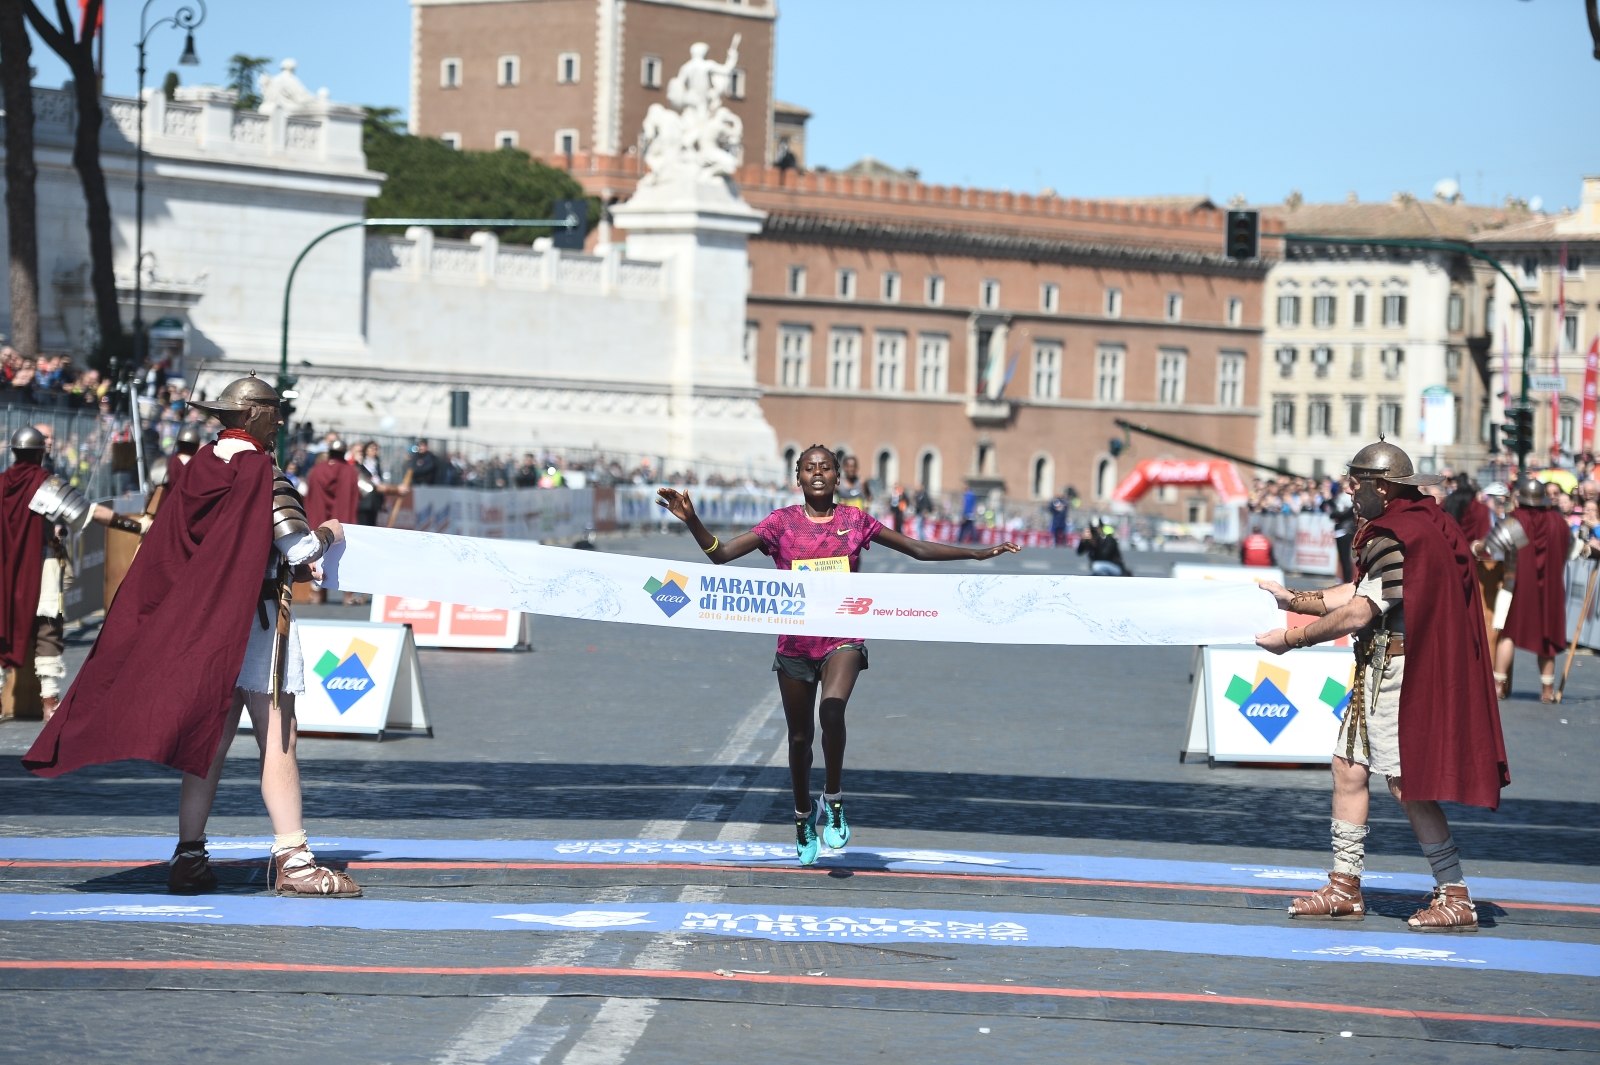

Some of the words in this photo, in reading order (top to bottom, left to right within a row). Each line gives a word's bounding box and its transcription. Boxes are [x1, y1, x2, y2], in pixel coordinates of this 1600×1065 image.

[700, 575, 806, 598] MARATONA
[656, 594, 685, 604] acea
[699, 593, 718, 611] di
[698, 611, 722, 620] 2016
[724, 613, 763, 623] Jubilee
[767, 616, 805, 625] Edition
[873, 608, 894, 616] new
[896, 608, 939, 617] balance
[326, 675, 370, 691] acea
[1245, 703, 1291, 718] acea
[684, 912, 1028, 930] MARATONA
